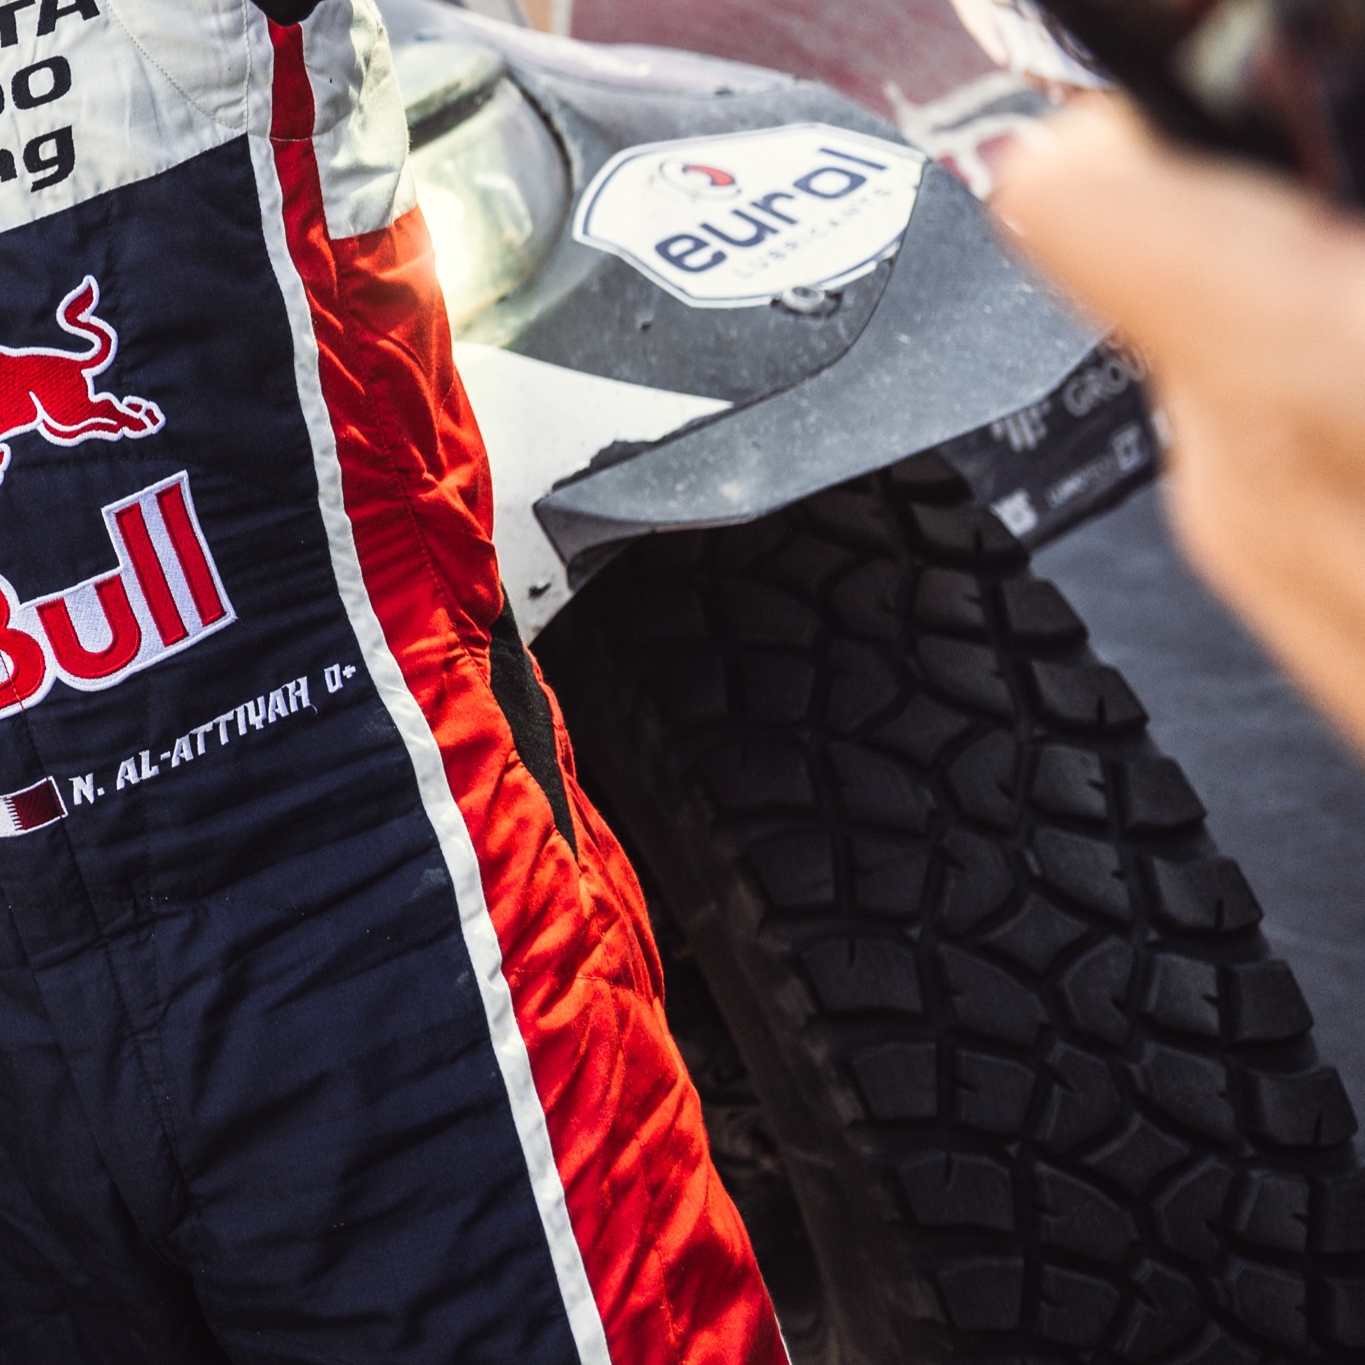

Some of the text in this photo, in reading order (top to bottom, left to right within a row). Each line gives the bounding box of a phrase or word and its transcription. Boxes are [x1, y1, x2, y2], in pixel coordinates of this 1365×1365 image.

[654, 146, 889, 273] eurol
[72, 774, 105, 805] N.
[116, 675, 312, 792] AL-ATTIYAH
